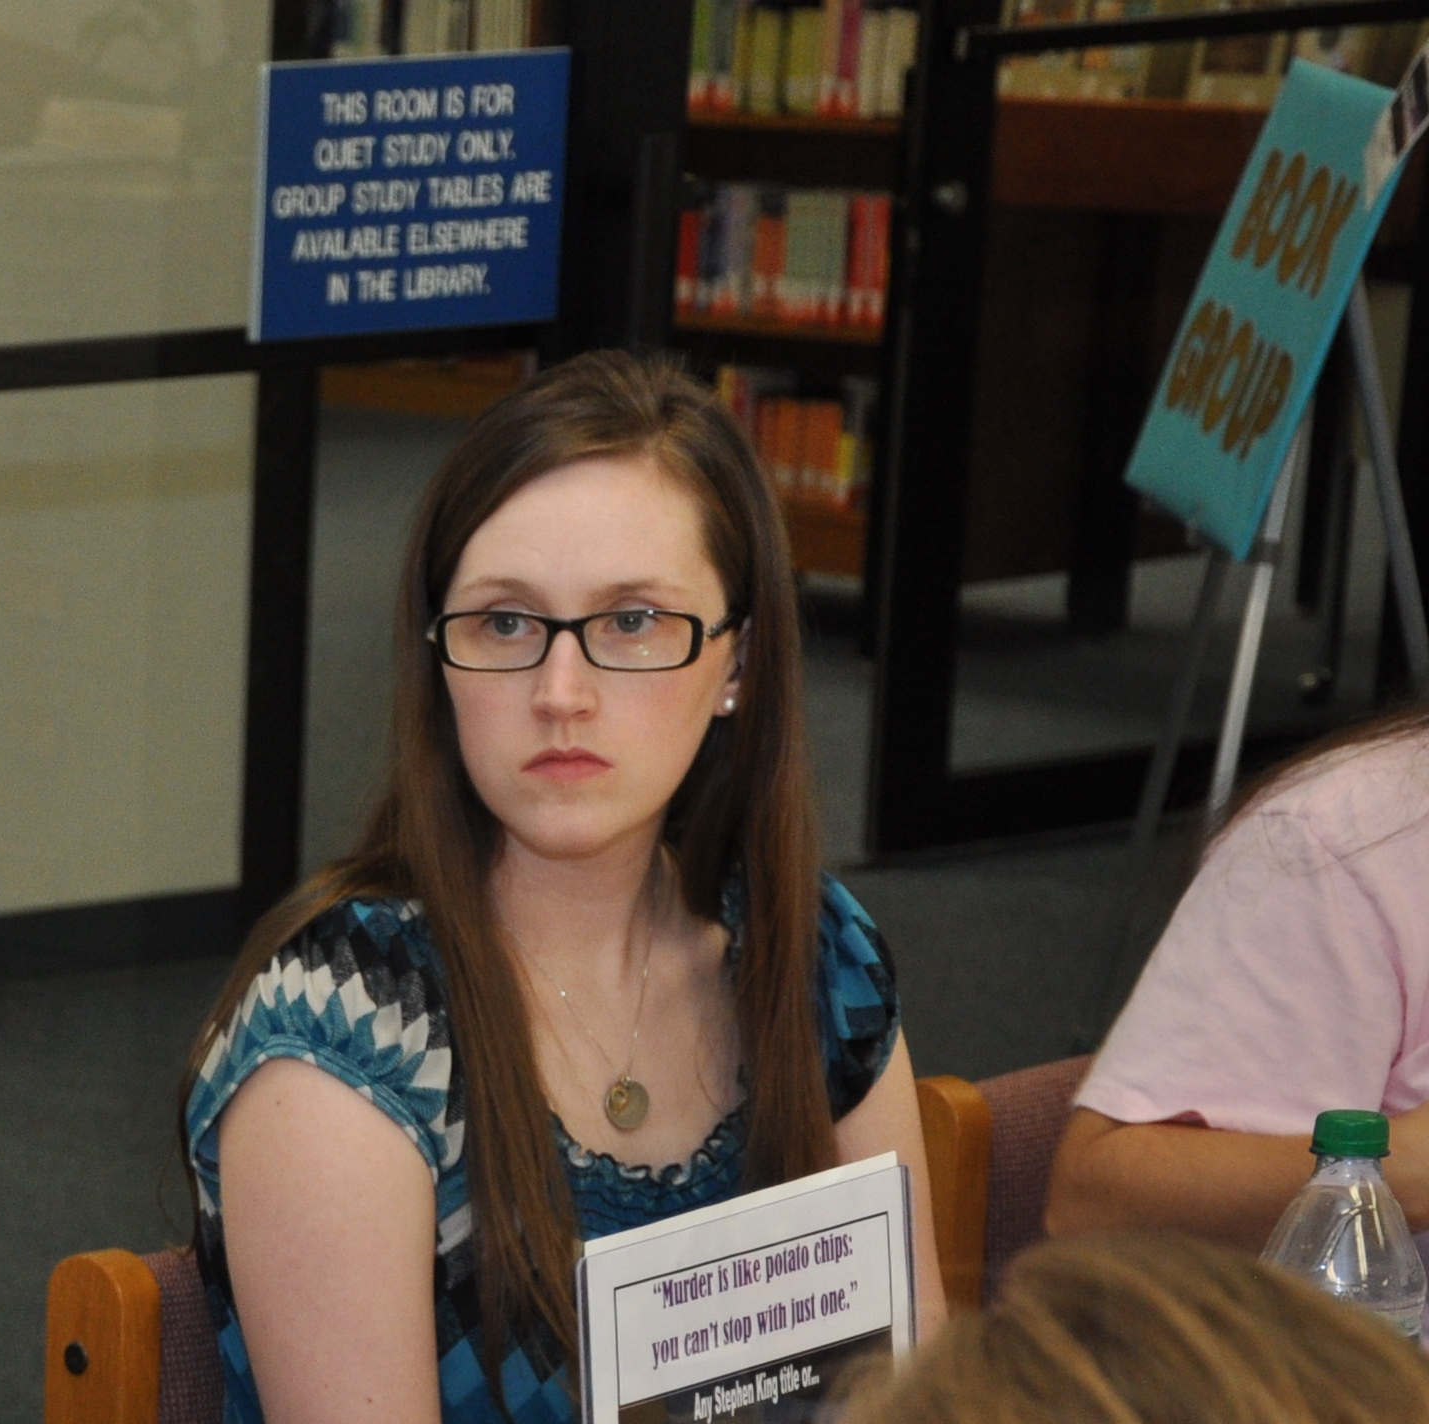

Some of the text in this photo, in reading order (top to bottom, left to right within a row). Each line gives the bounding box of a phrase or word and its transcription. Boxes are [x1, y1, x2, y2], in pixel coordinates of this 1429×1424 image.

[321, 83, 514, 125] THIS ROOM IS FOR
[314, 129, 515, 171] QUIET STUDY ONLY.
[273, 170, 553, 218] GROUP STUDY TABLES ARE
[292, 217, 530, 262] AVAILABLE ELSEWHERE
[1230, 147, 1362, 299] BOOK
[327, 264, 491, 304] IN THE LIBRARY.
[1165, 295, 1295, 464] GROUP
[718, 1265, 729, 1294] is
[733, 1258, 762, 1289] like
[765, 1244, 810, 1283] potato
[814, 1233, 854, 1266] chips:
[652, 1333, 681, 1370] you
[724, 1315, 752, 1345] stop
[756, 1302, 788, 1335] with
[791, 1295, 816, 1331] just
[693, 1393, 714, 1424] Any
[714, 1379, 755, 1417] Stephen
[756, 1372, 778, 1404] King
[779, 1364, 800, 1392] title
